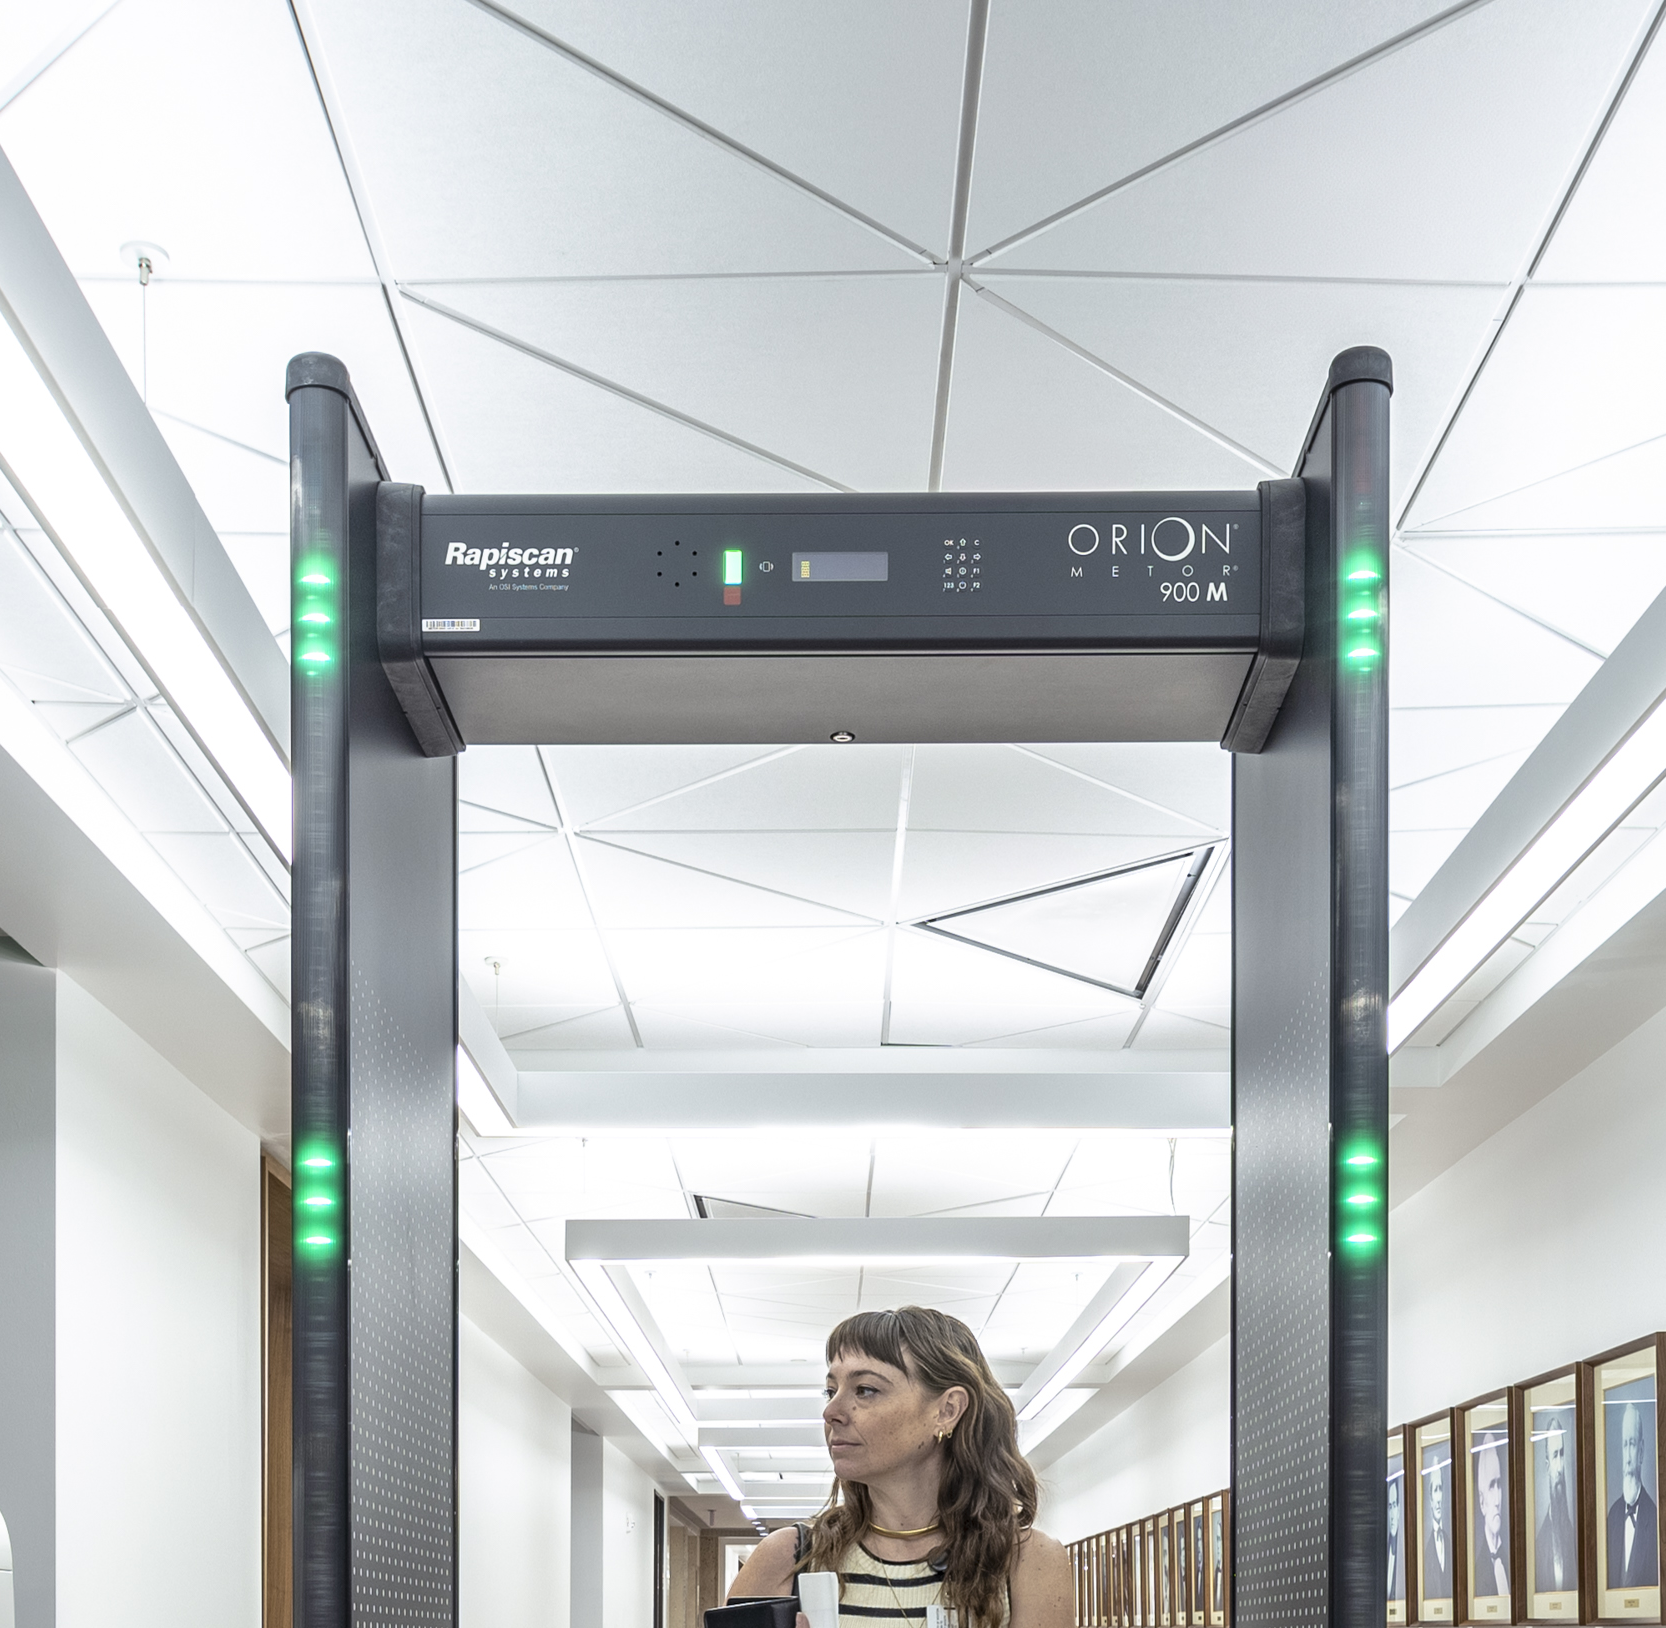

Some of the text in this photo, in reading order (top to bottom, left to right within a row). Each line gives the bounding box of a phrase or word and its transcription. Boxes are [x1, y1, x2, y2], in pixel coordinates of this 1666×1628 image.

[1068, 516, 1230, 562] ORION
[444, 541, 574, 570] Rapiscan
[488, 567, 570, 580] systems
[1070, 565, 1230, 578] METOR
[511, 583, 538, 591] Systems
[539, 583, 569, 591] Company
[1160, 582, 1228, 602] 900 M
